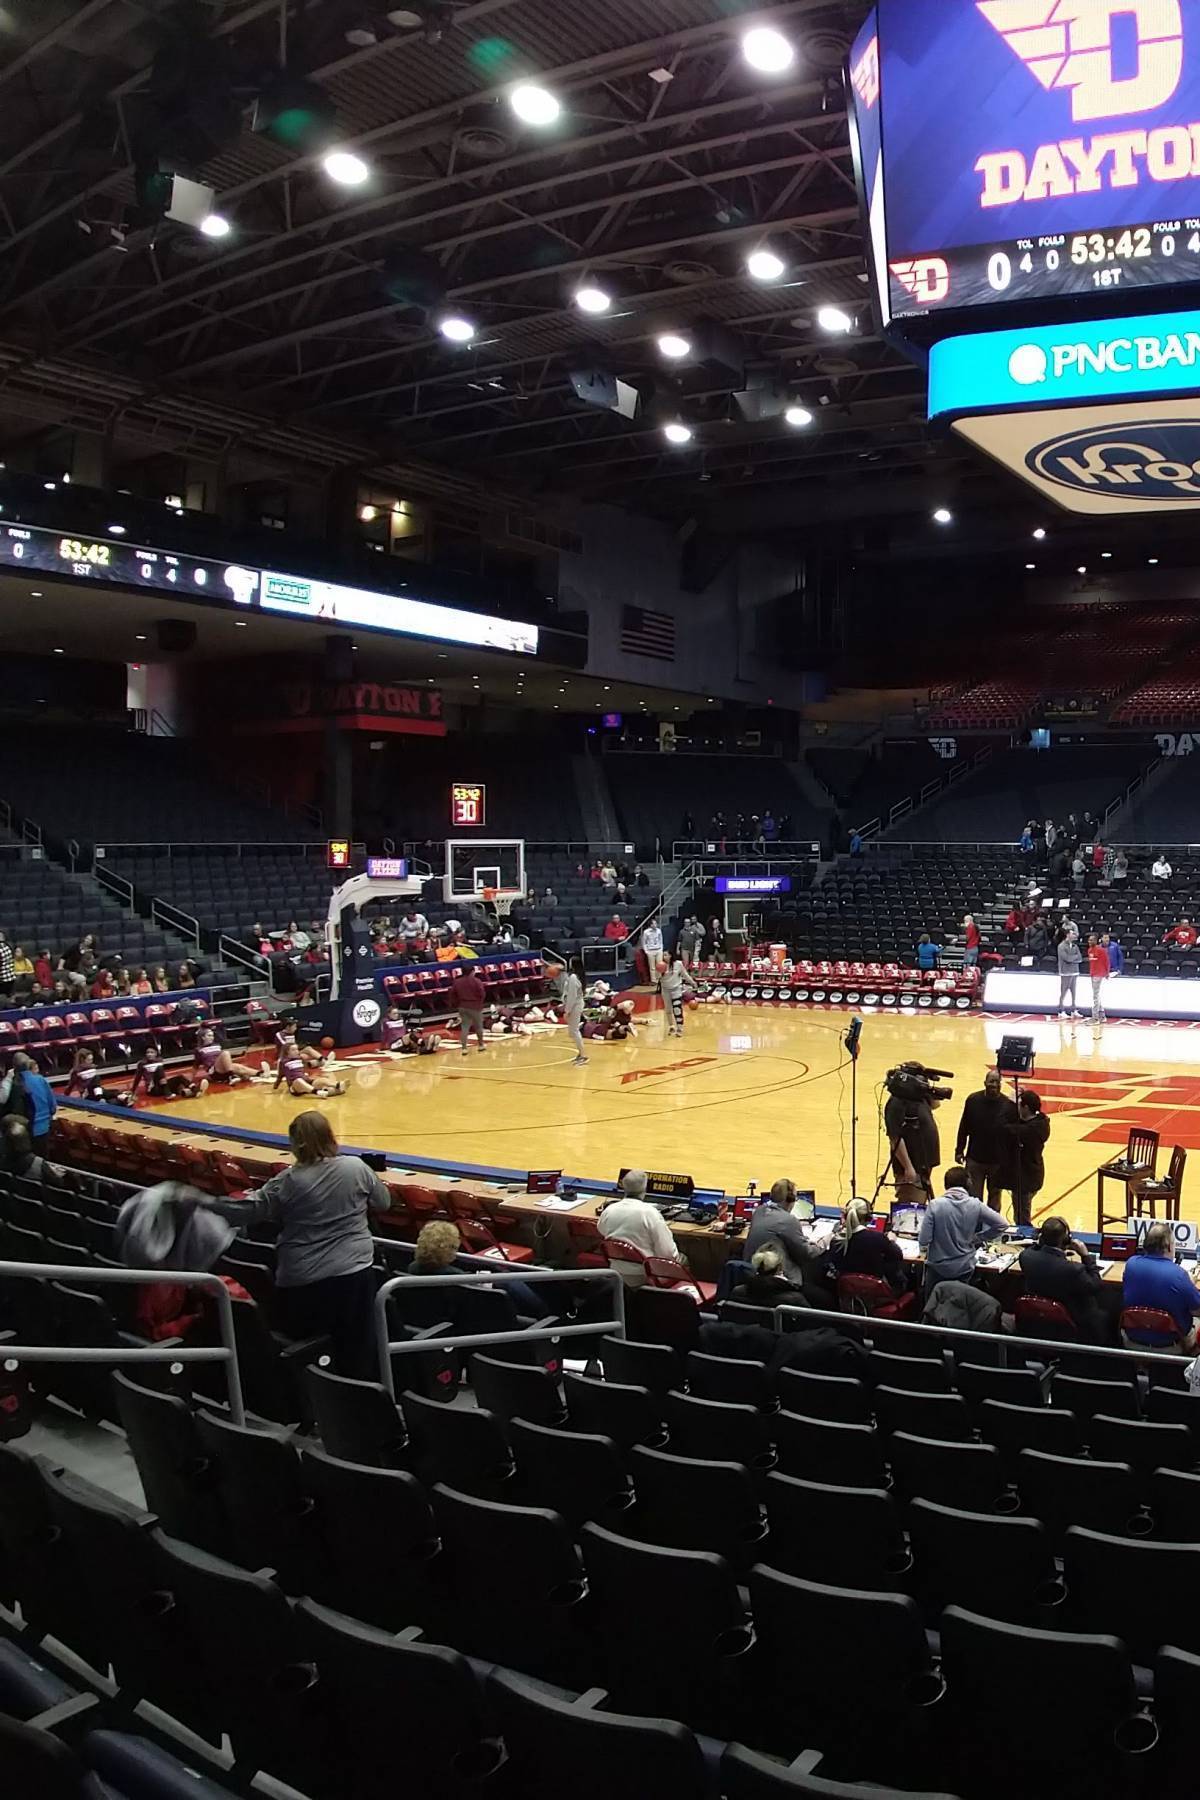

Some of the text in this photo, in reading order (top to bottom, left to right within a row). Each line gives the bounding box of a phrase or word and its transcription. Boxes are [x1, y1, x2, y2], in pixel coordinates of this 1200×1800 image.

[1071, 228, 1151, 264] 53:42
[1161, 232, 1200, 256] 0 4
[988, 252, 1011, 290] 0
[1020, 250, 1059, 272] 4 0
[1093, 268, 1122, 287] 1ST
[1051, 337, 1132, 377] PNC
[60, 538, 109, 565] 53:42
[457, 801, 476, 821] 30
[653, 1183, 674, 1192] RADIO
[1134, 1220, 1191, 1241] WO
